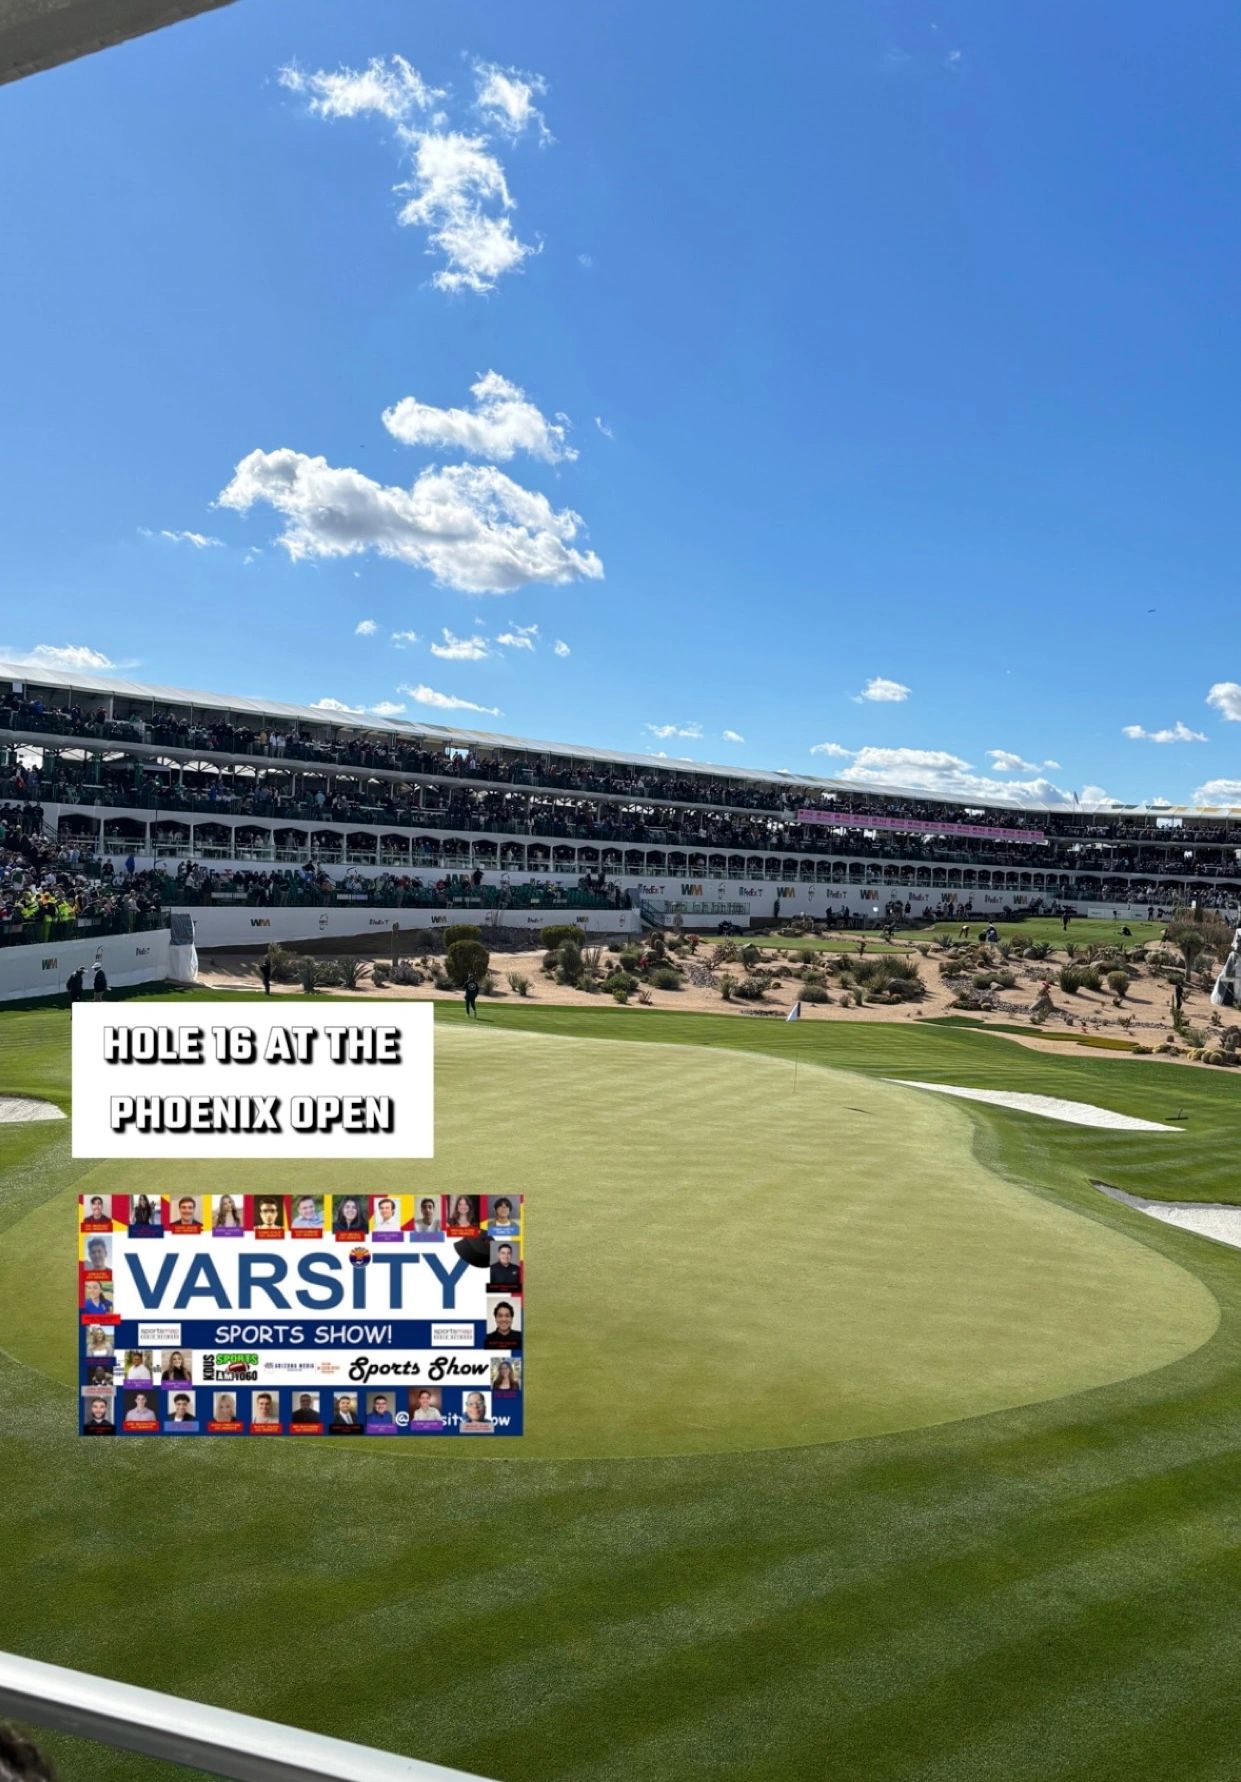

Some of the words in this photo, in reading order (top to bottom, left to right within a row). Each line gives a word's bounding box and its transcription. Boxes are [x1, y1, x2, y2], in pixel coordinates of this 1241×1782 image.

[680, 883, 703, 897] WM
[776, 886, 796, 899] WM
[860, 889, 880, 901] WM
[941, 892, 958, 903] WM
[250, 918, 271, 927] WM
[42, 957, 58, 971] WM
